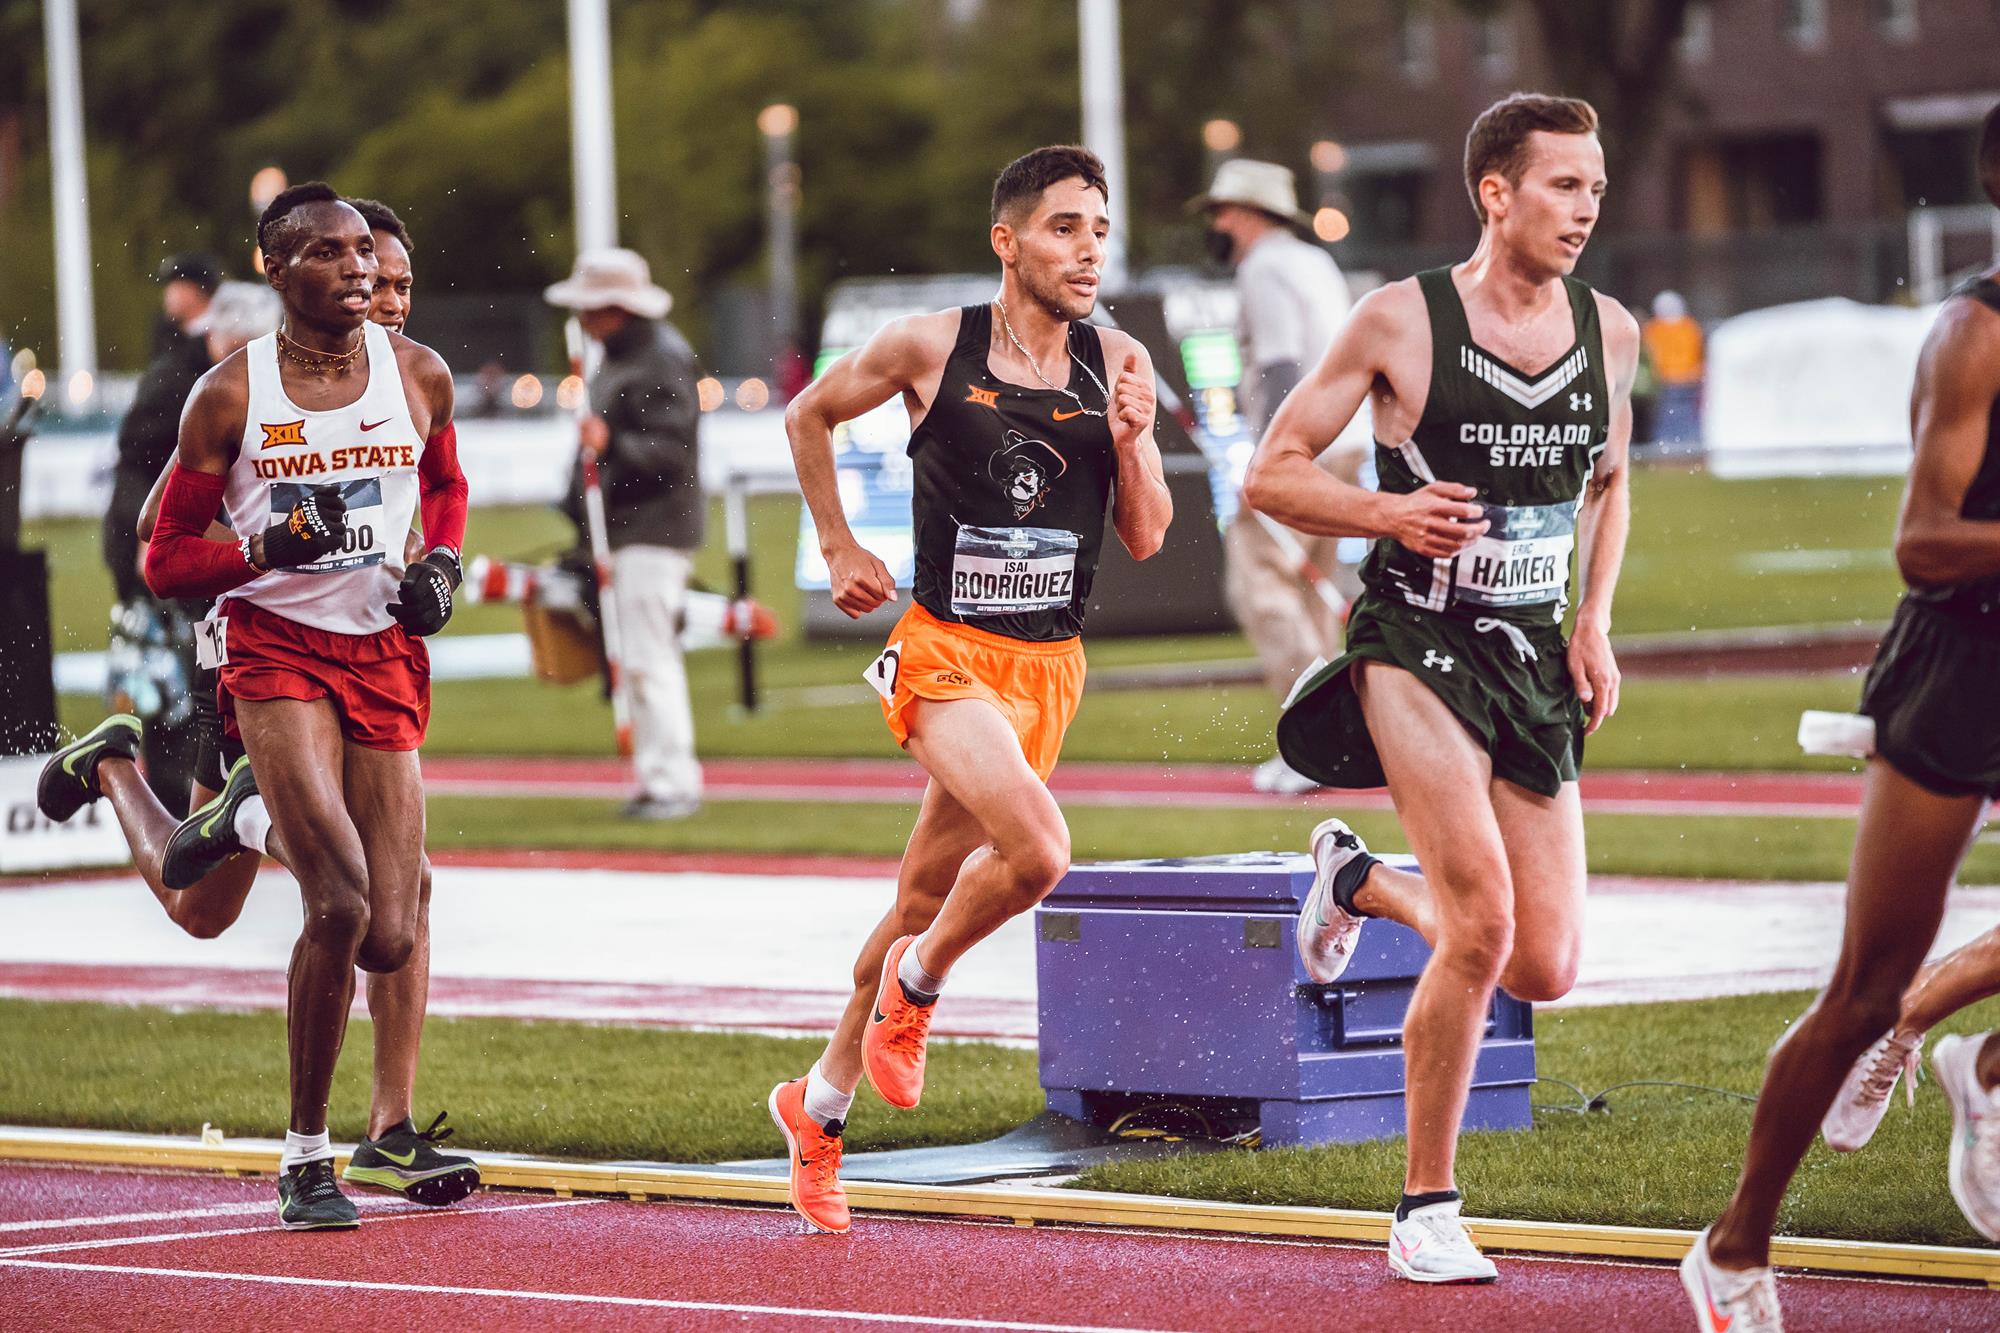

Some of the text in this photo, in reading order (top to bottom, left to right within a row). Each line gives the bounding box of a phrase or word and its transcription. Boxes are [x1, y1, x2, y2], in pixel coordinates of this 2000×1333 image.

[260, 419, 308, 450] XII
[1460, 423, 1591, 445] COLORADO
[251, 445, 415, 479] IOWA STATE
[1490, 445, 1564, 467] STATE
[302, 501, 321, 533] WESLEY
[1512, 543, 1534, 556] ERIC
[1004, 562, 1028, 573] ISAI
[1471, 555, 1556, 588] HAMER
[437, 576, 450, 607] WESLEY
[954, 569, 1072, 599] RODRIGUEZ
